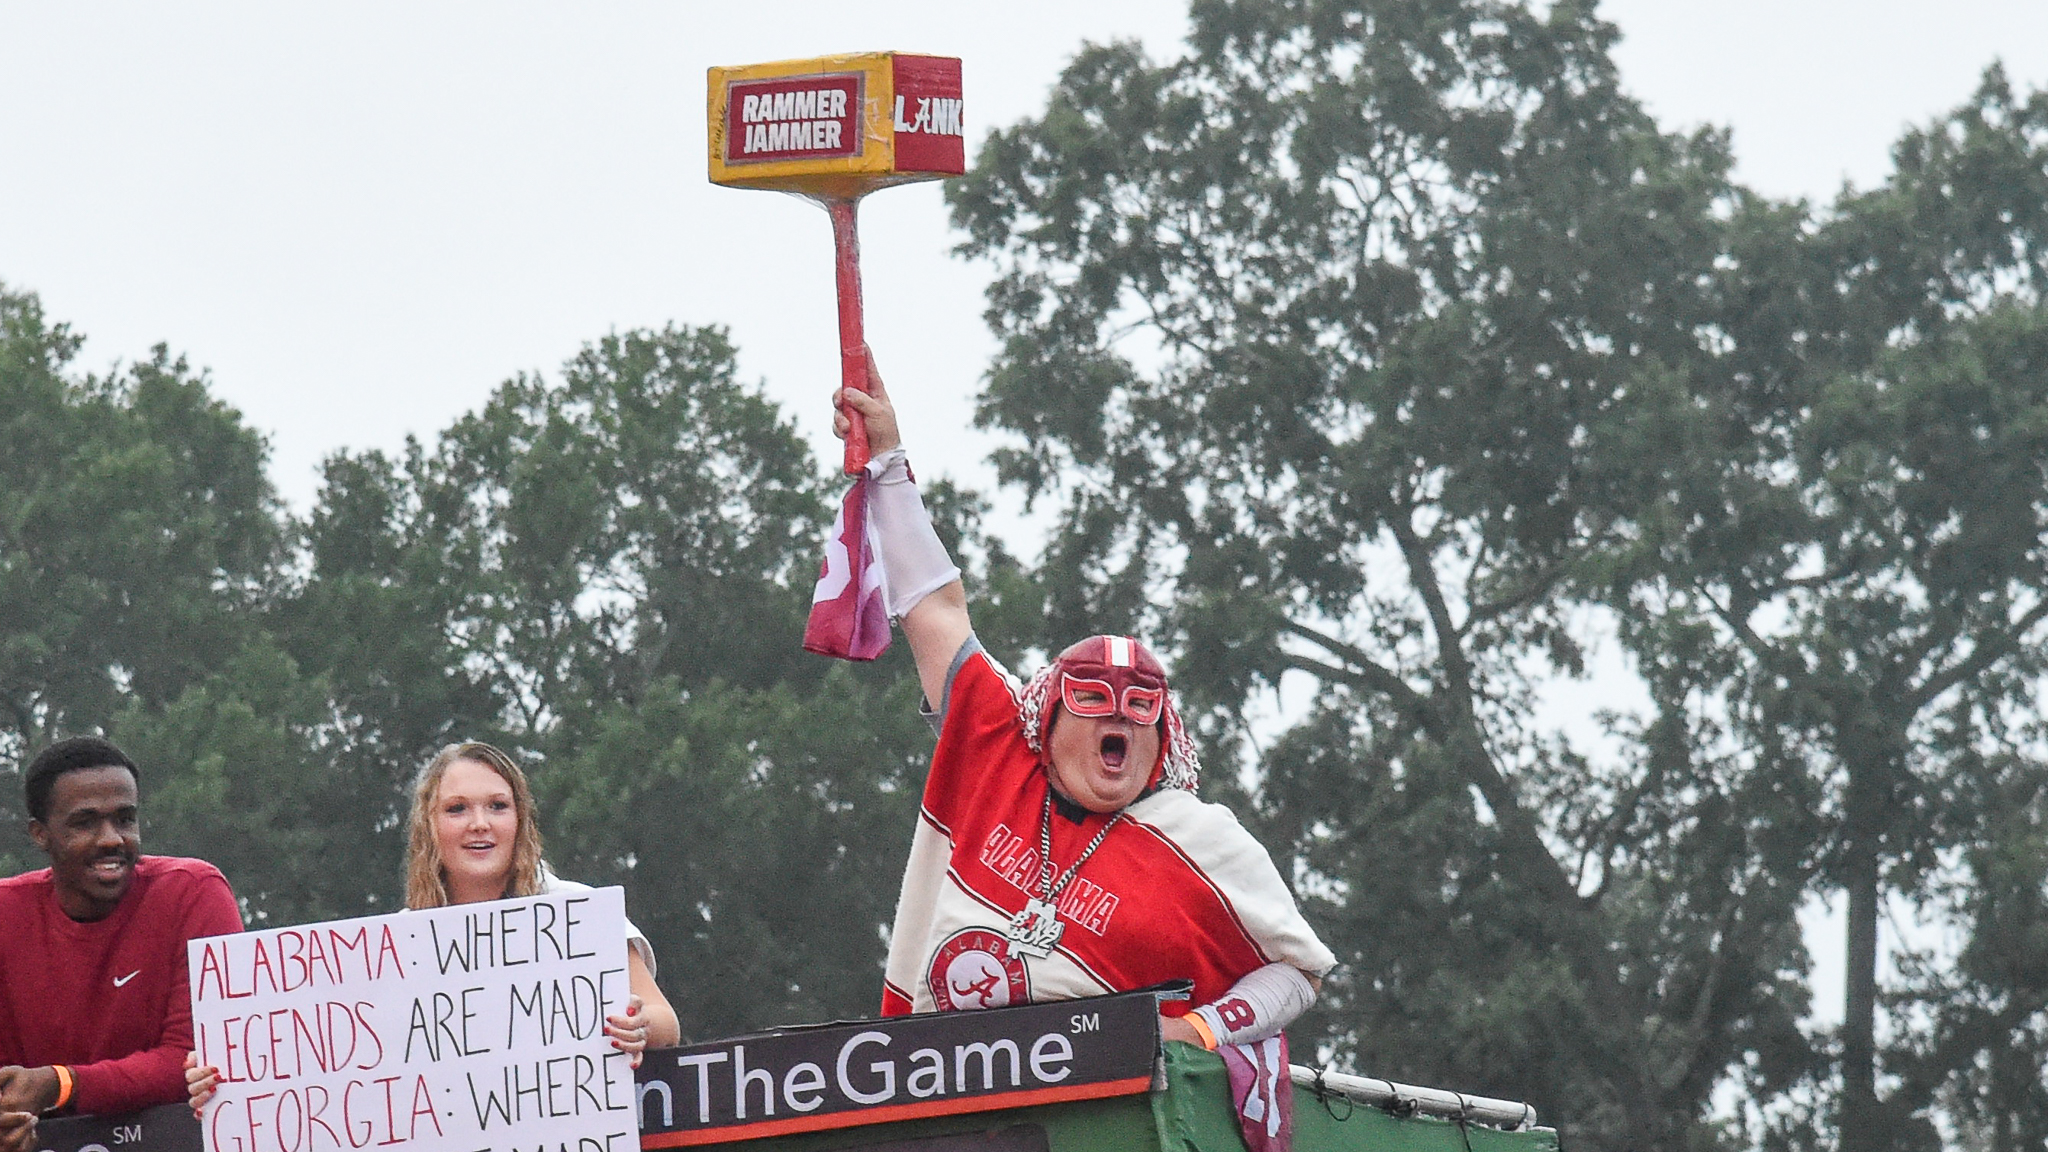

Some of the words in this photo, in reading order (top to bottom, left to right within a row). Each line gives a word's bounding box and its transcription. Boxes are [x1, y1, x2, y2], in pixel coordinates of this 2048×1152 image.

[742, 89, 847, 123] RAMMER
[743, 120, 842, 154] JAMMER
[198, 923, 419, 1002] ALABAMA:
[429, 897, 597, 975] WHERE
[199, 1001, 384, 1083] LEGENDS
[404, 987, 491, 1064] ARE
[507, 968, 626, 1051] MADE
[1070, 1013, 1101, 1034] SM
[466, 1051, 629, 1131] WHERE
[113, 1124, 142, 1145] SM
